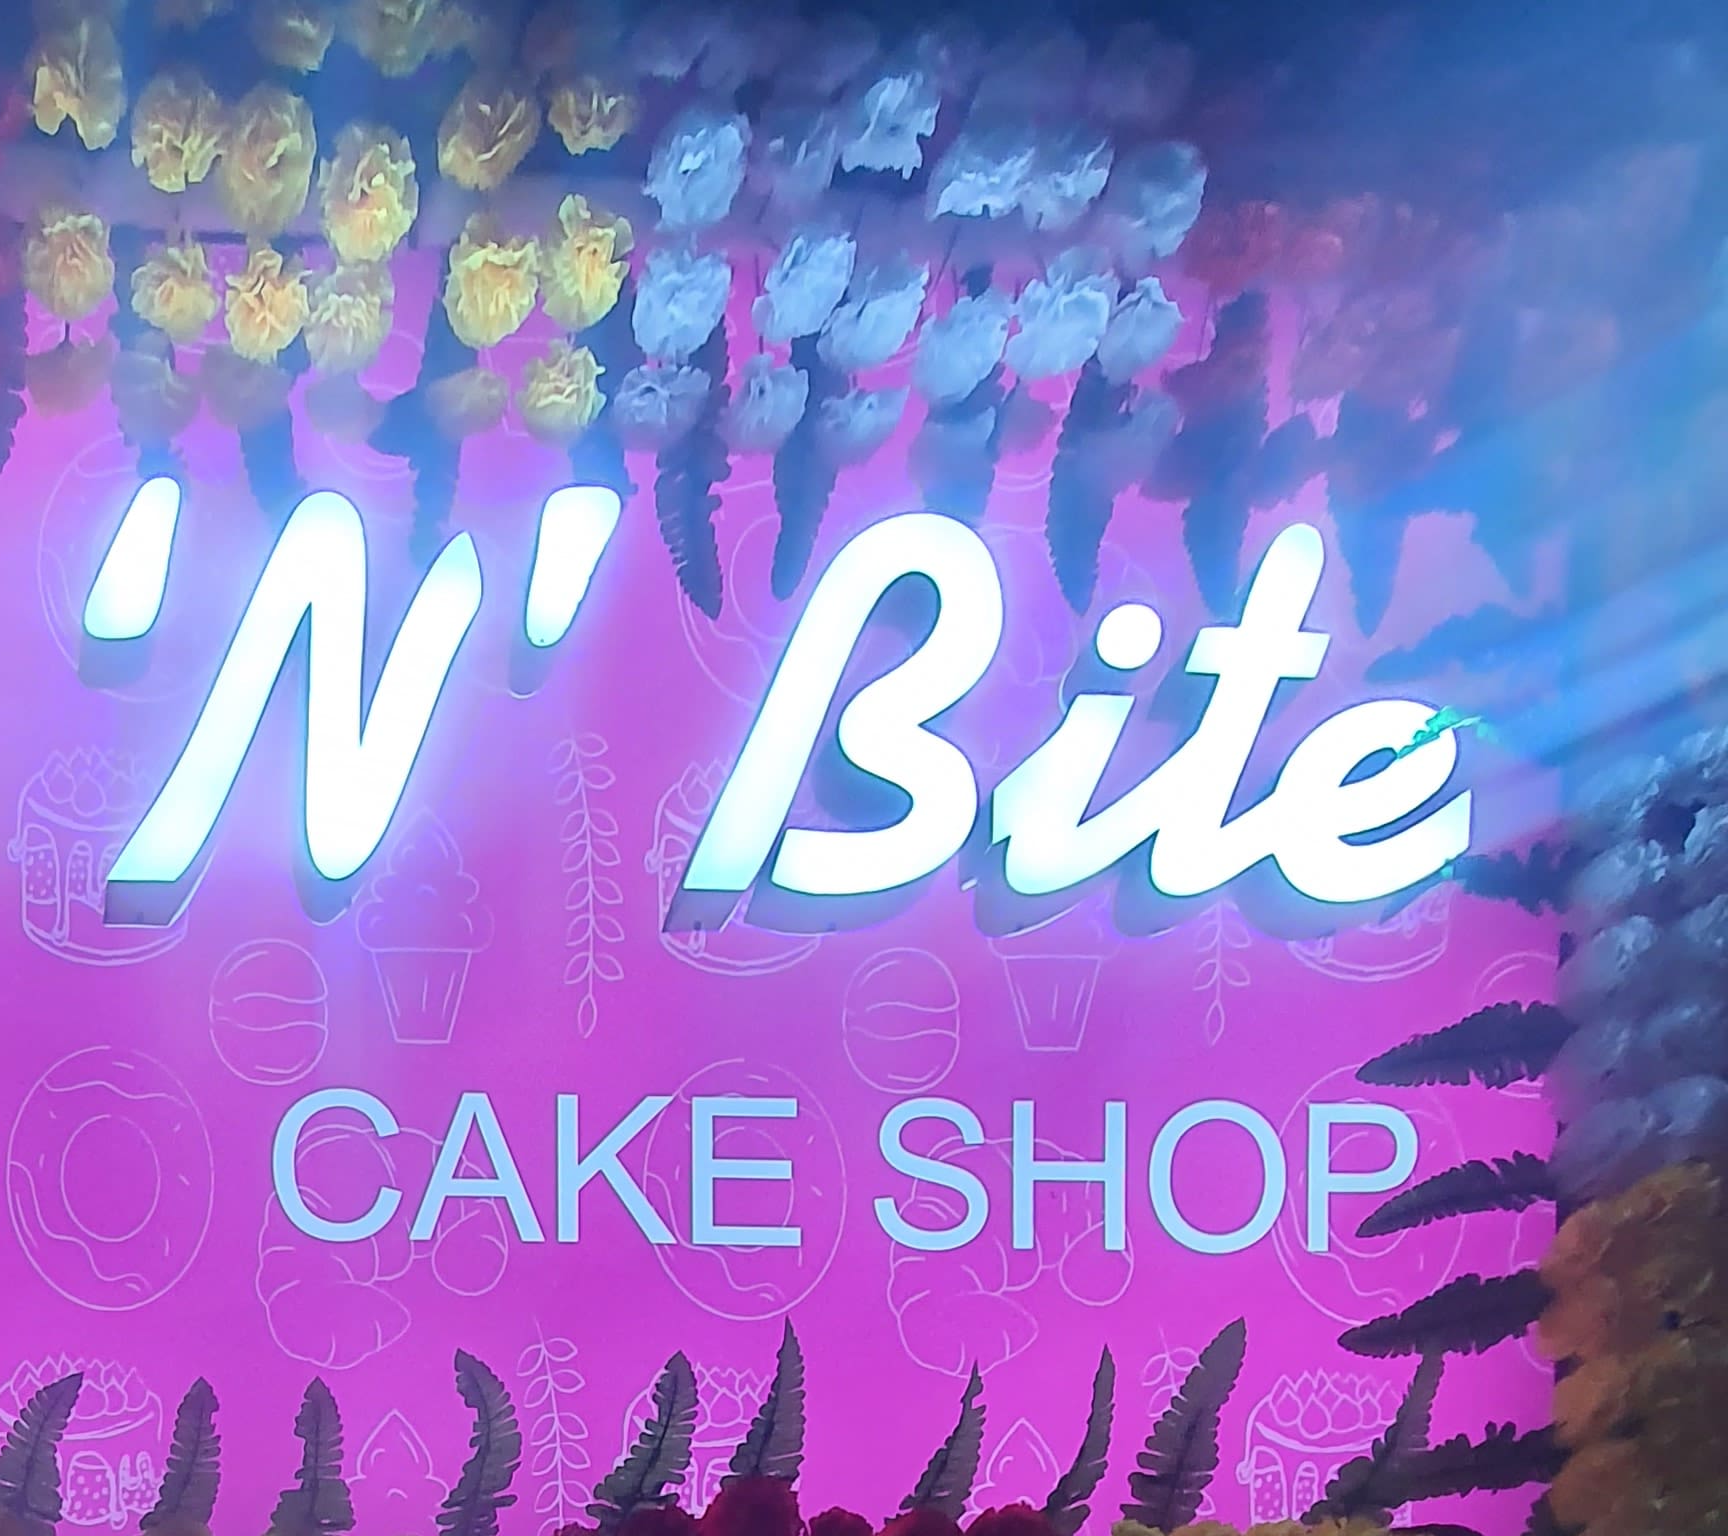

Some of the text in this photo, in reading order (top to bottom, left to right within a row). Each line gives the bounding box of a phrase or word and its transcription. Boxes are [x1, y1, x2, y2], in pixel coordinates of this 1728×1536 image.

[82, 476, 622, 885] 'N'
[680, 511, 1472, 904] Bite
[272, 1087, 1421, 1256] CAKE SHOP
